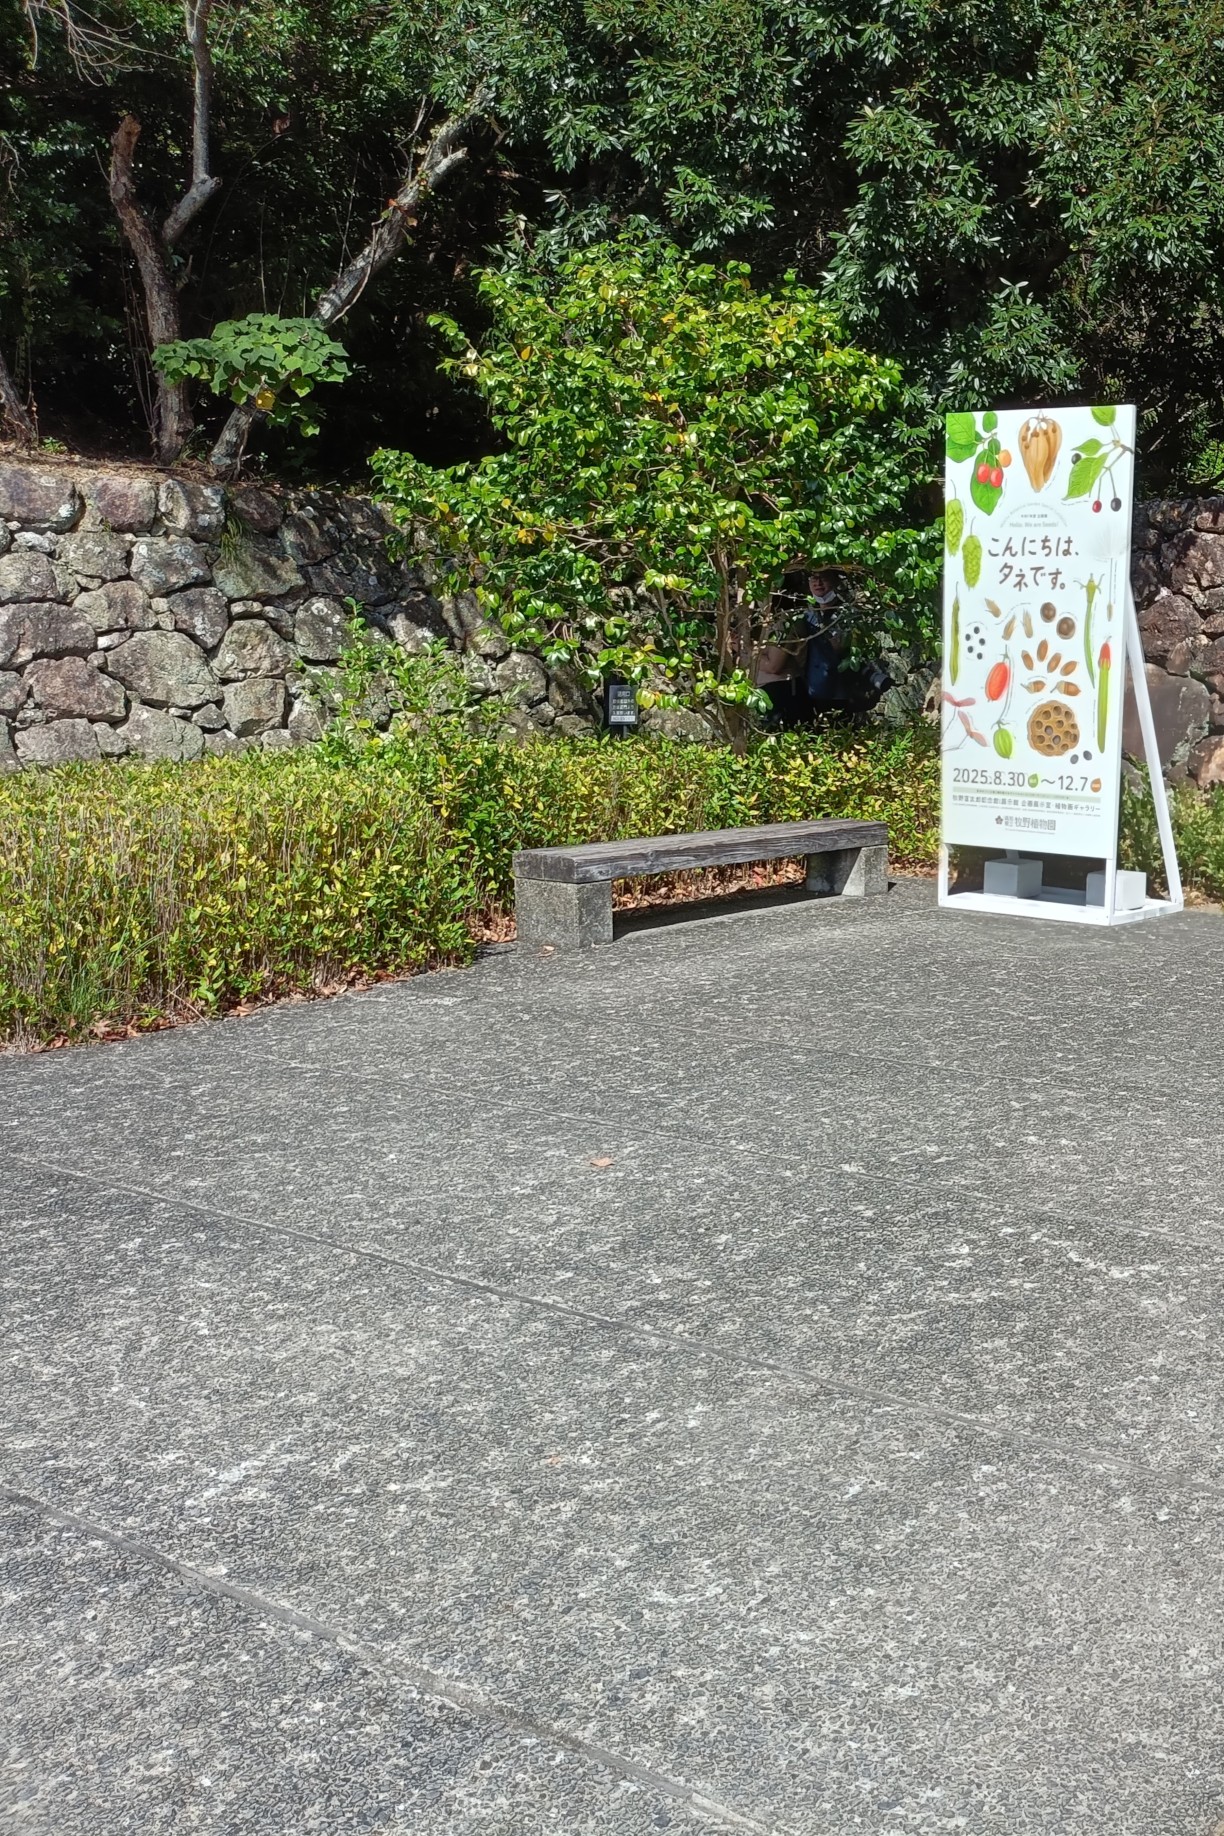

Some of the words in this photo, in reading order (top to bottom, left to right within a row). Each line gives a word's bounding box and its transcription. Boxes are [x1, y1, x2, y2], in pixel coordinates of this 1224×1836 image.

[987, 535, 1080, 557] こんにちは、
[998, 562, 1066, 592] タネです。
[953, 767, 1026, 787] 2025.8.30
[1015, 816, 1056, 831] 牧野植物園
